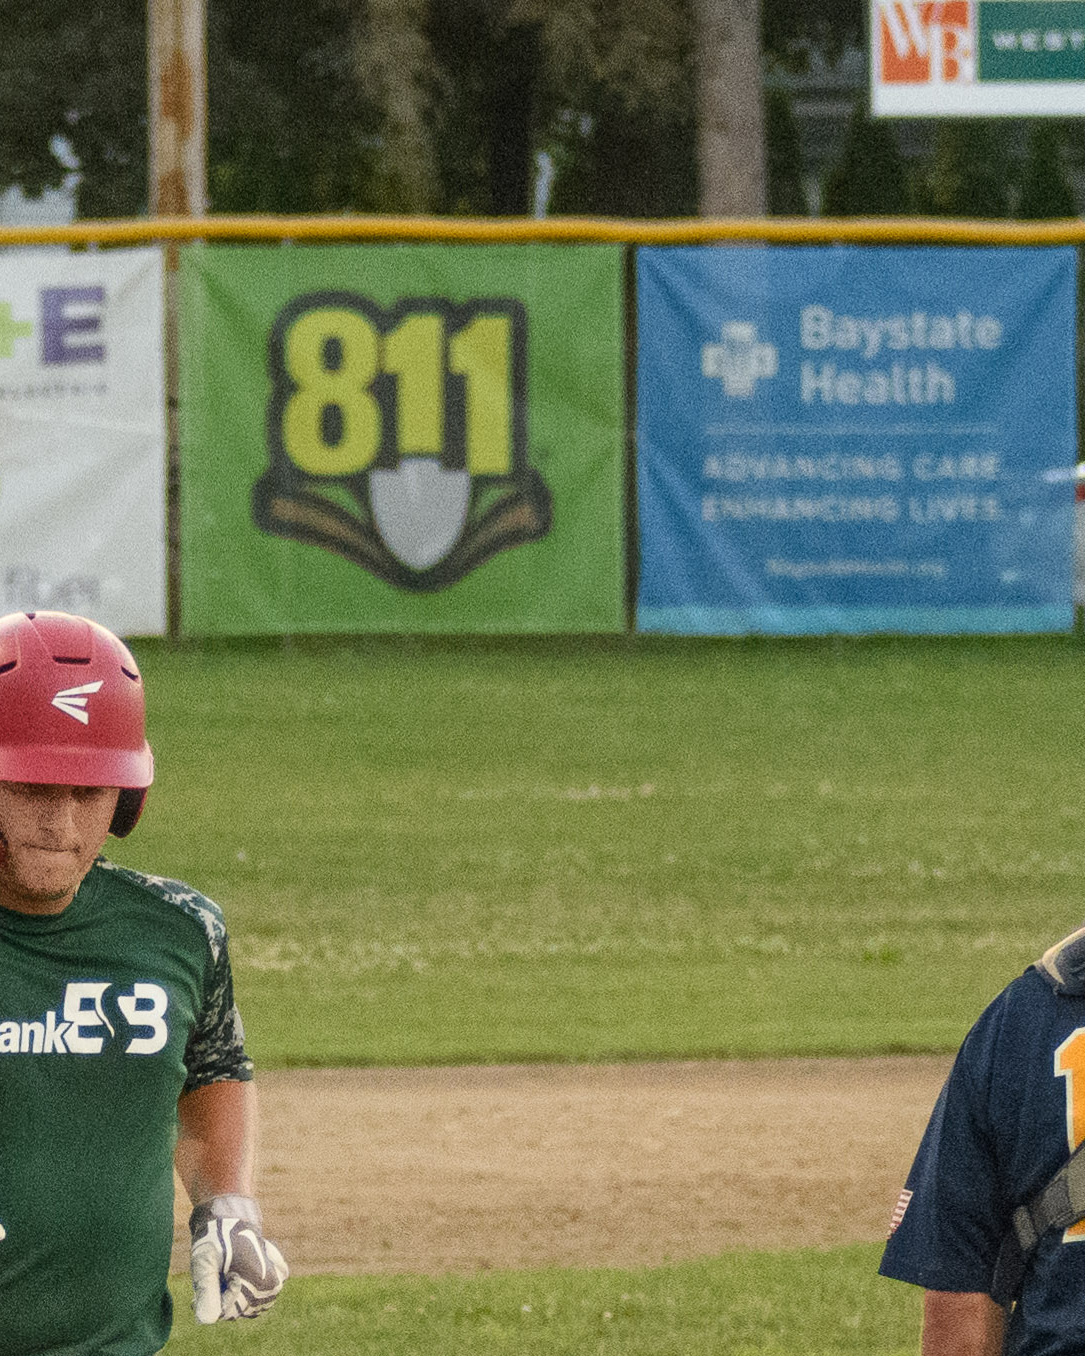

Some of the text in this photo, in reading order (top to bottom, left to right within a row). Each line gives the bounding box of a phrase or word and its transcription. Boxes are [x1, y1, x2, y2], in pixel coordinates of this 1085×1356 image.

[800, 304, 1004, 360] Baystate
[282, 308, 514, 478] 811
[800, 361, 957, 405] Health
[703, 451, 1002, 482] ADVANCING CARE
